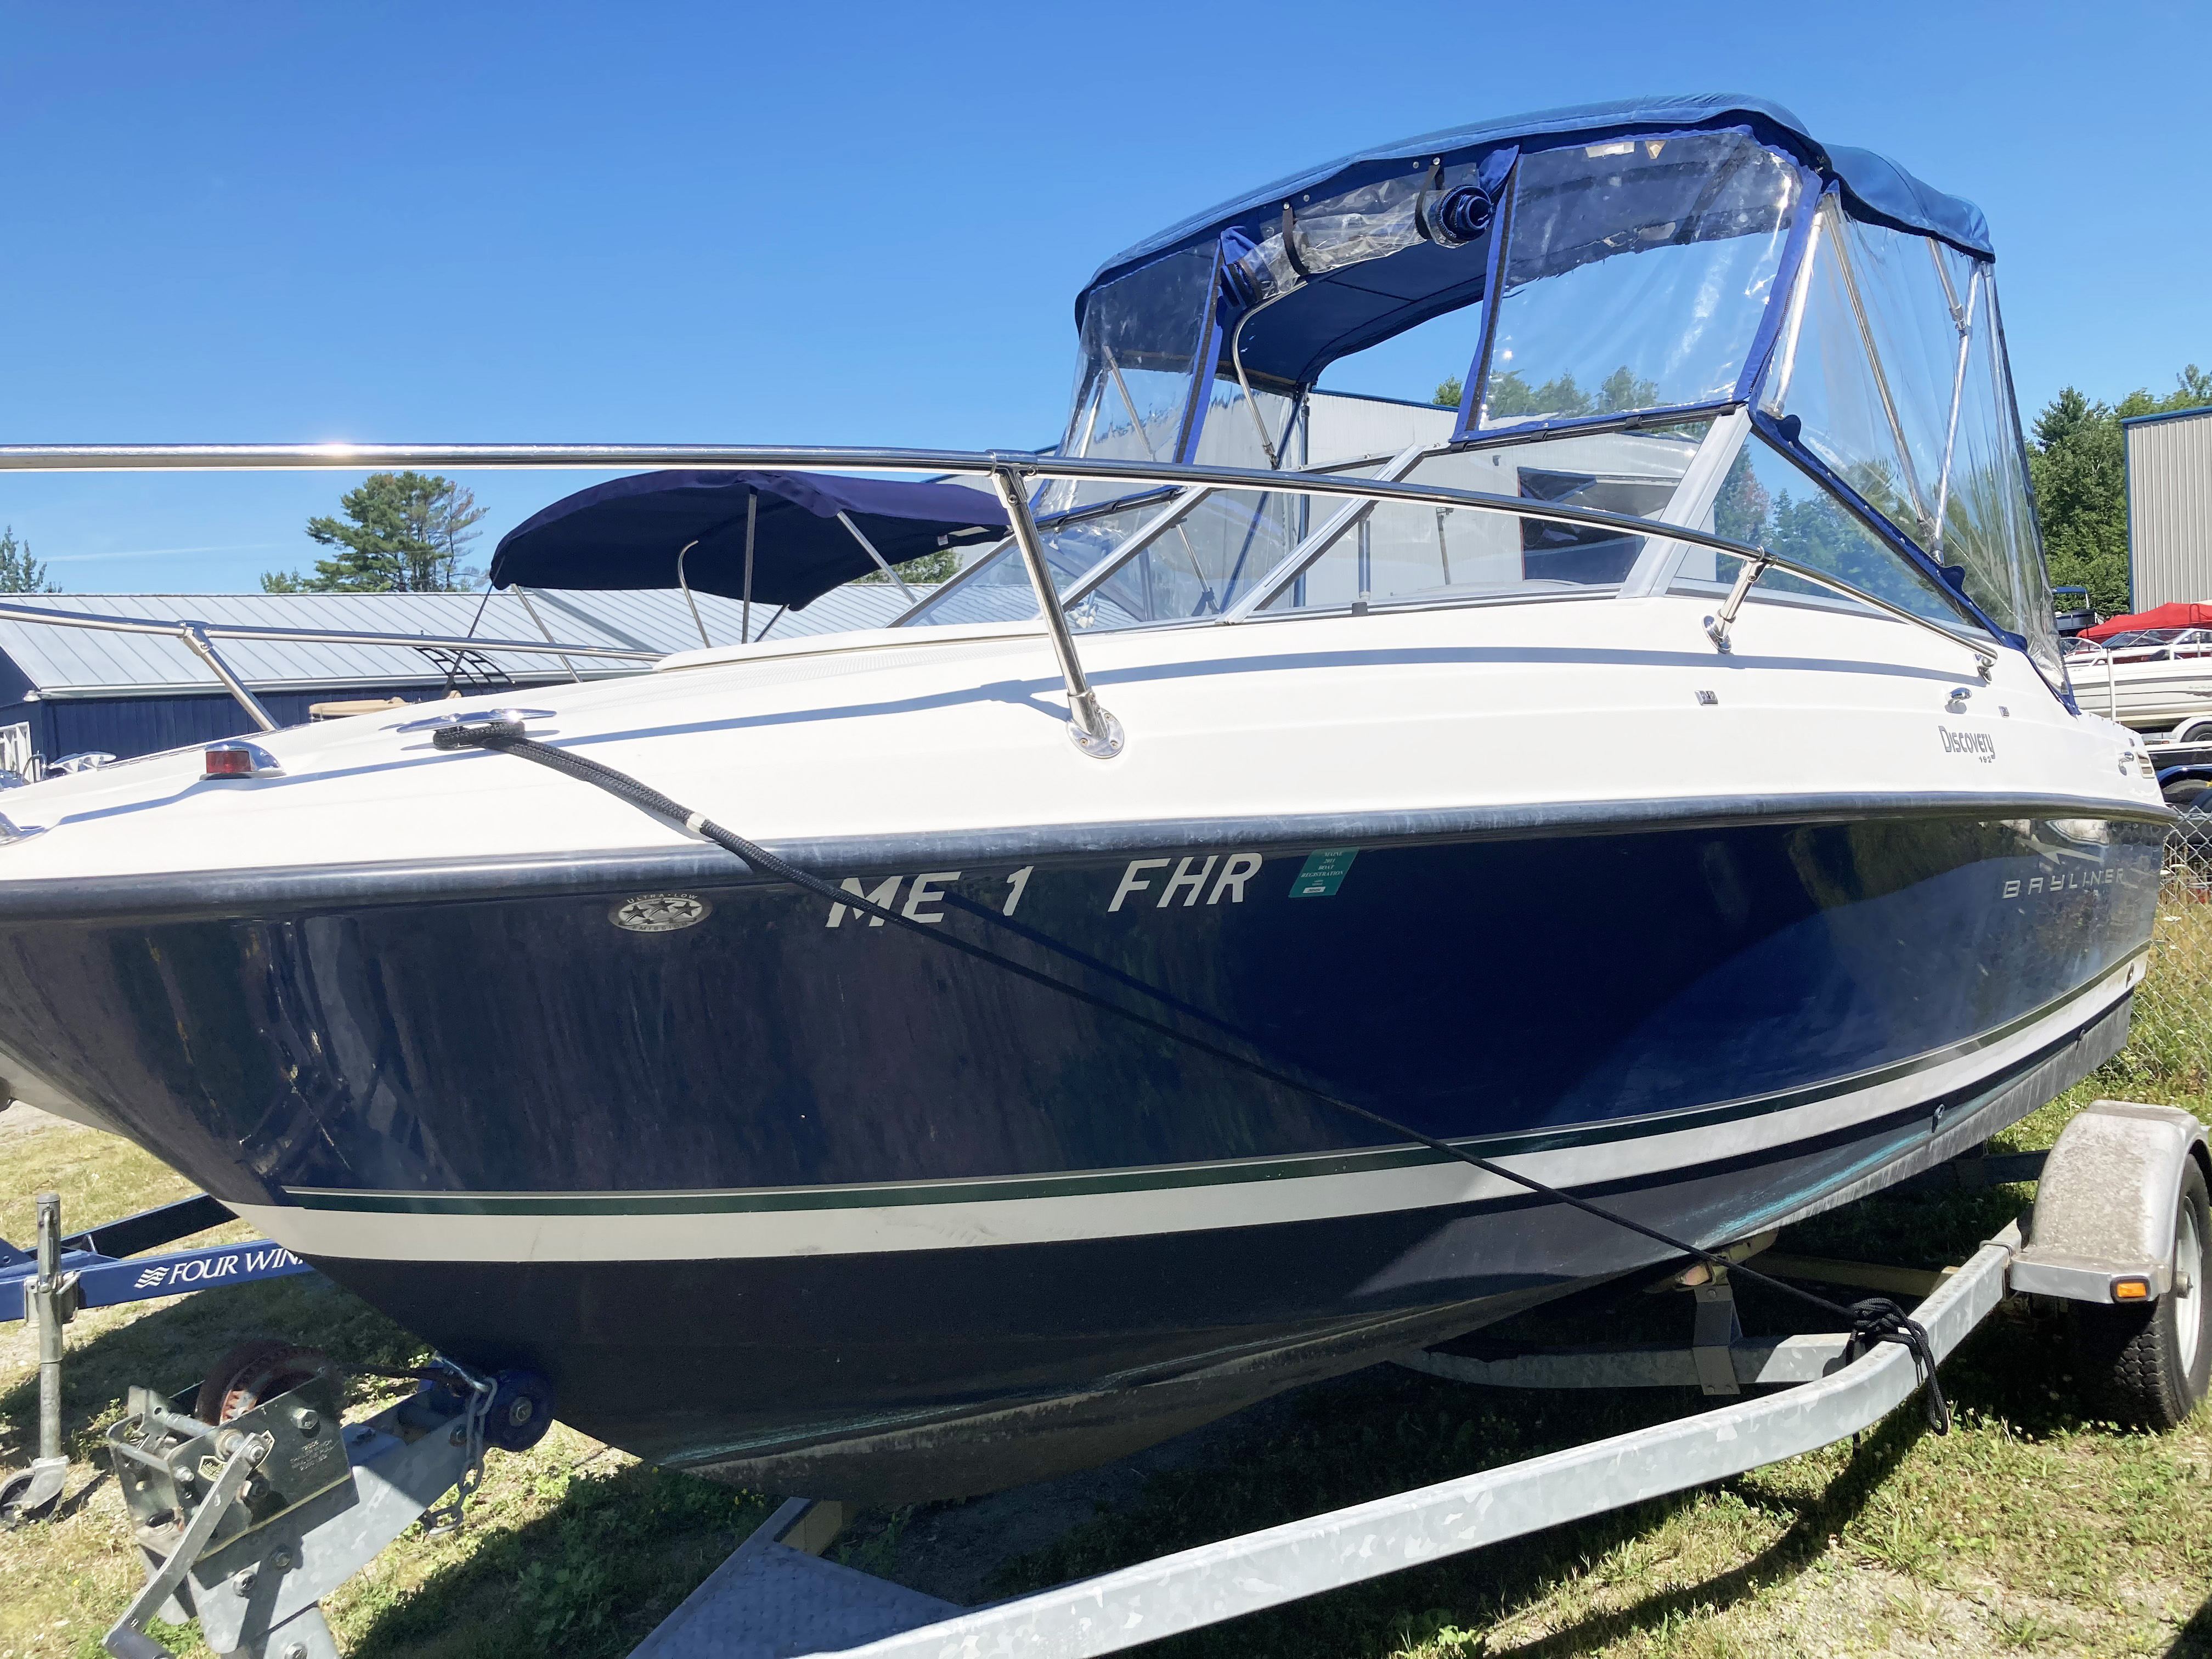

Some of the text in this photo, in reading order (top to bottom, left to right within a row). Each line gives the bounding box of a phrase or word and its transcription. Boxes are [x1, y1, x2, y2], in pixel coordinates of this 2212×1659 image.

[825, 852, 1262, 928] ME 1 FHR
[2002, 868, 2124, 899] BAYLINER
[168, 1248, 303, 1285] FOUR WIN
